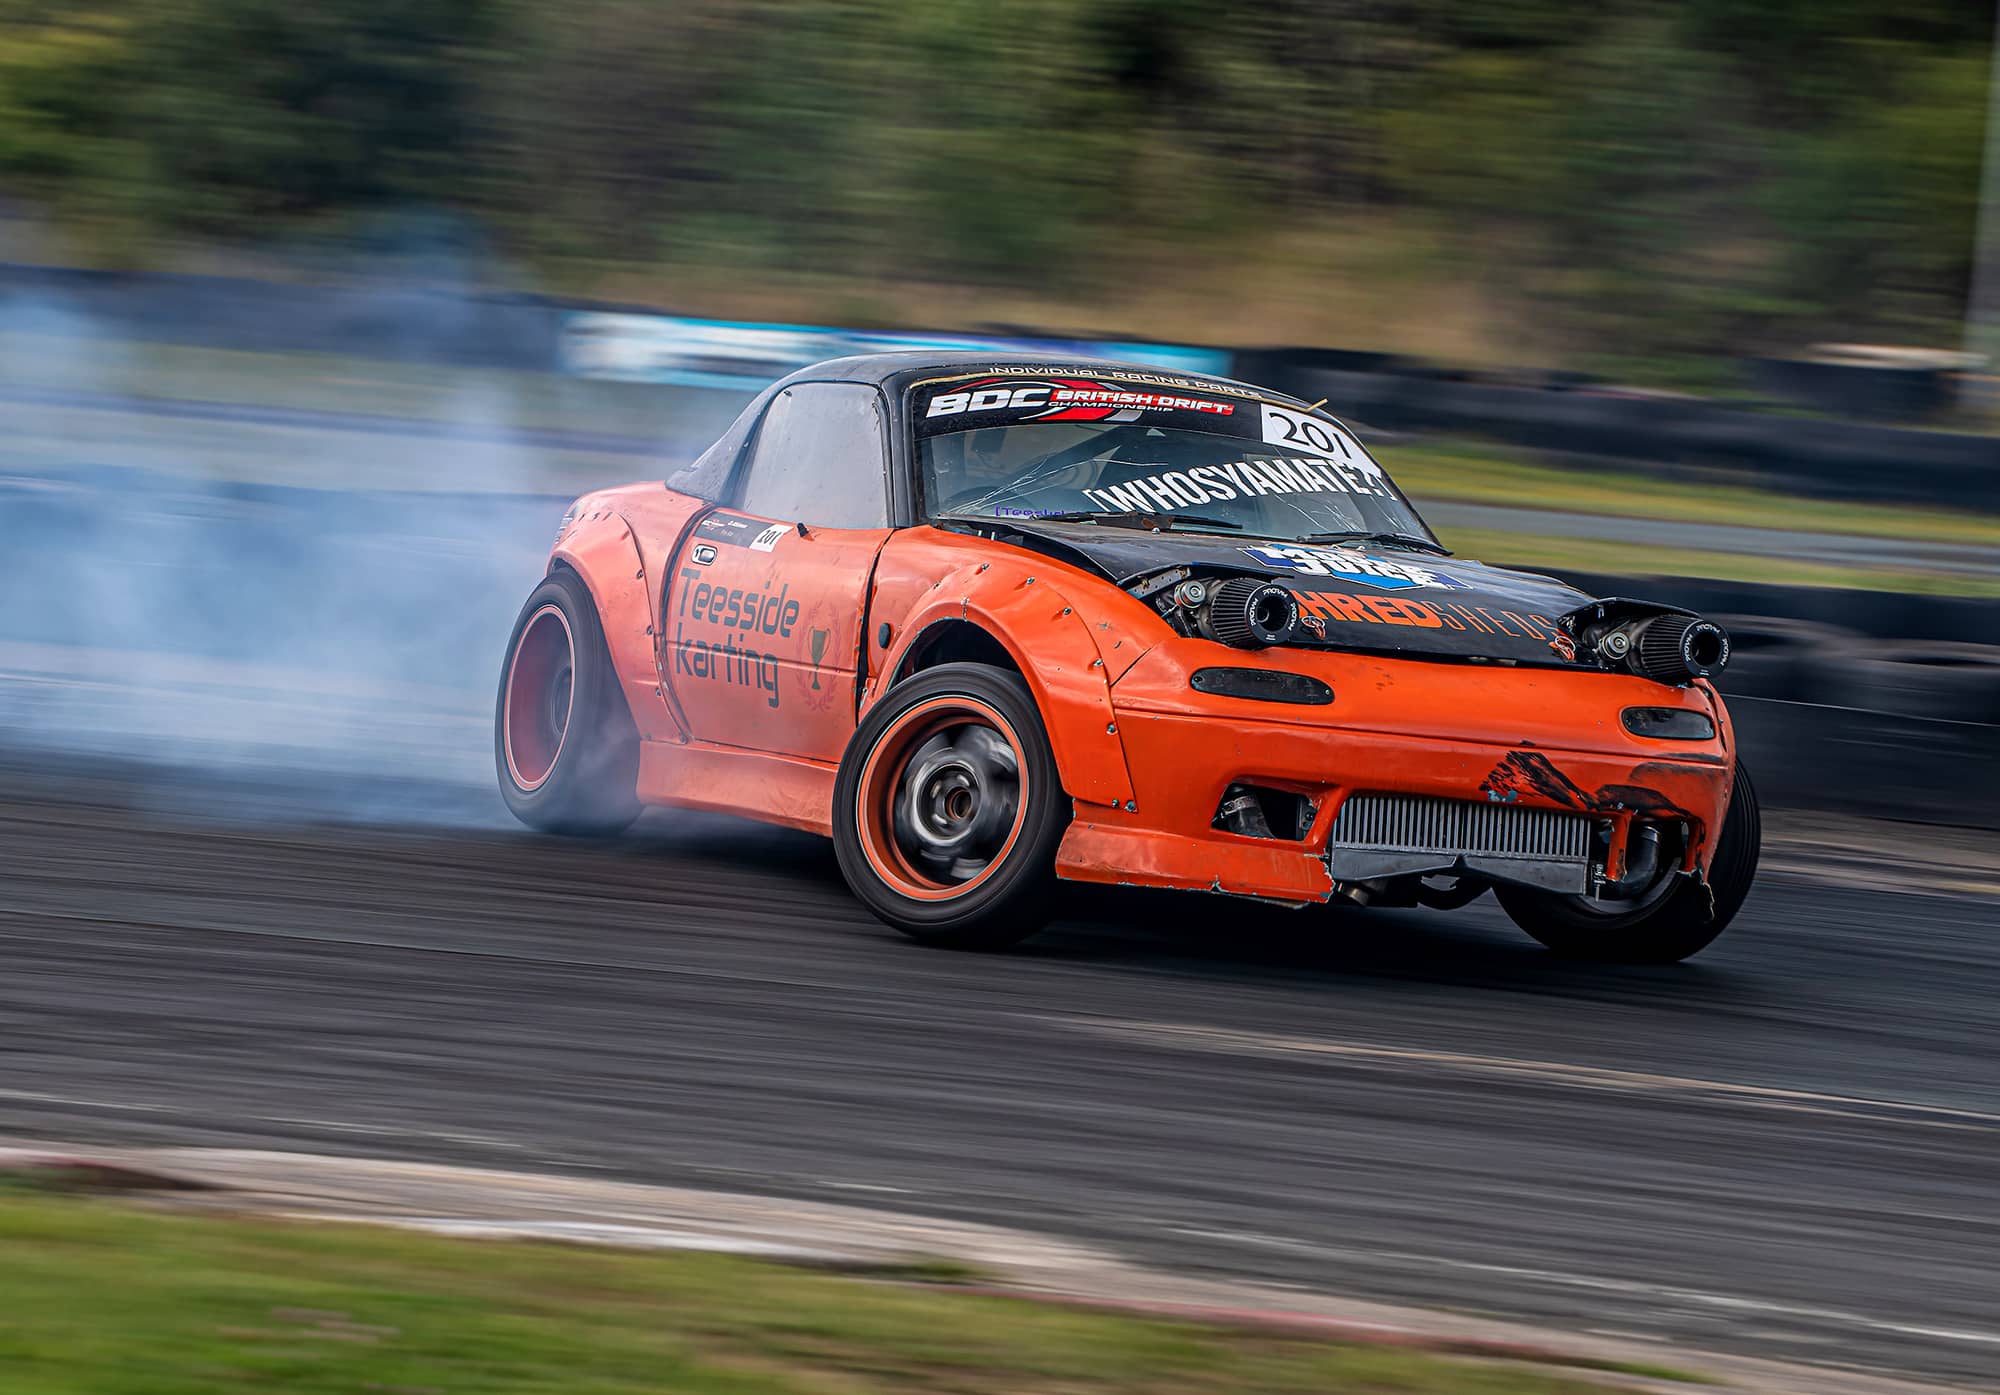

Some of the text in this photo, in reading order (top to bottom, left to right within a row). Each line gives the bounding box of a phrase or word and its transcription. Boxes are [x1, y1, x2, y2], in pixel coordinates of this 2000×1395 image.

[989, 366, 1263, 398] INDIVIDUAL RACING PARTS
[926, 387, 1051, 419] BDC
[1048, 400, 1175, 412] CHAMPIONSHIP
[1056, 389, 1229, 413] BRITISH DRIFT
[1269, 412, 1352, 460] 201
[678, 566, 800, 638] Teesside
[675, 622, 780, 709] karting
